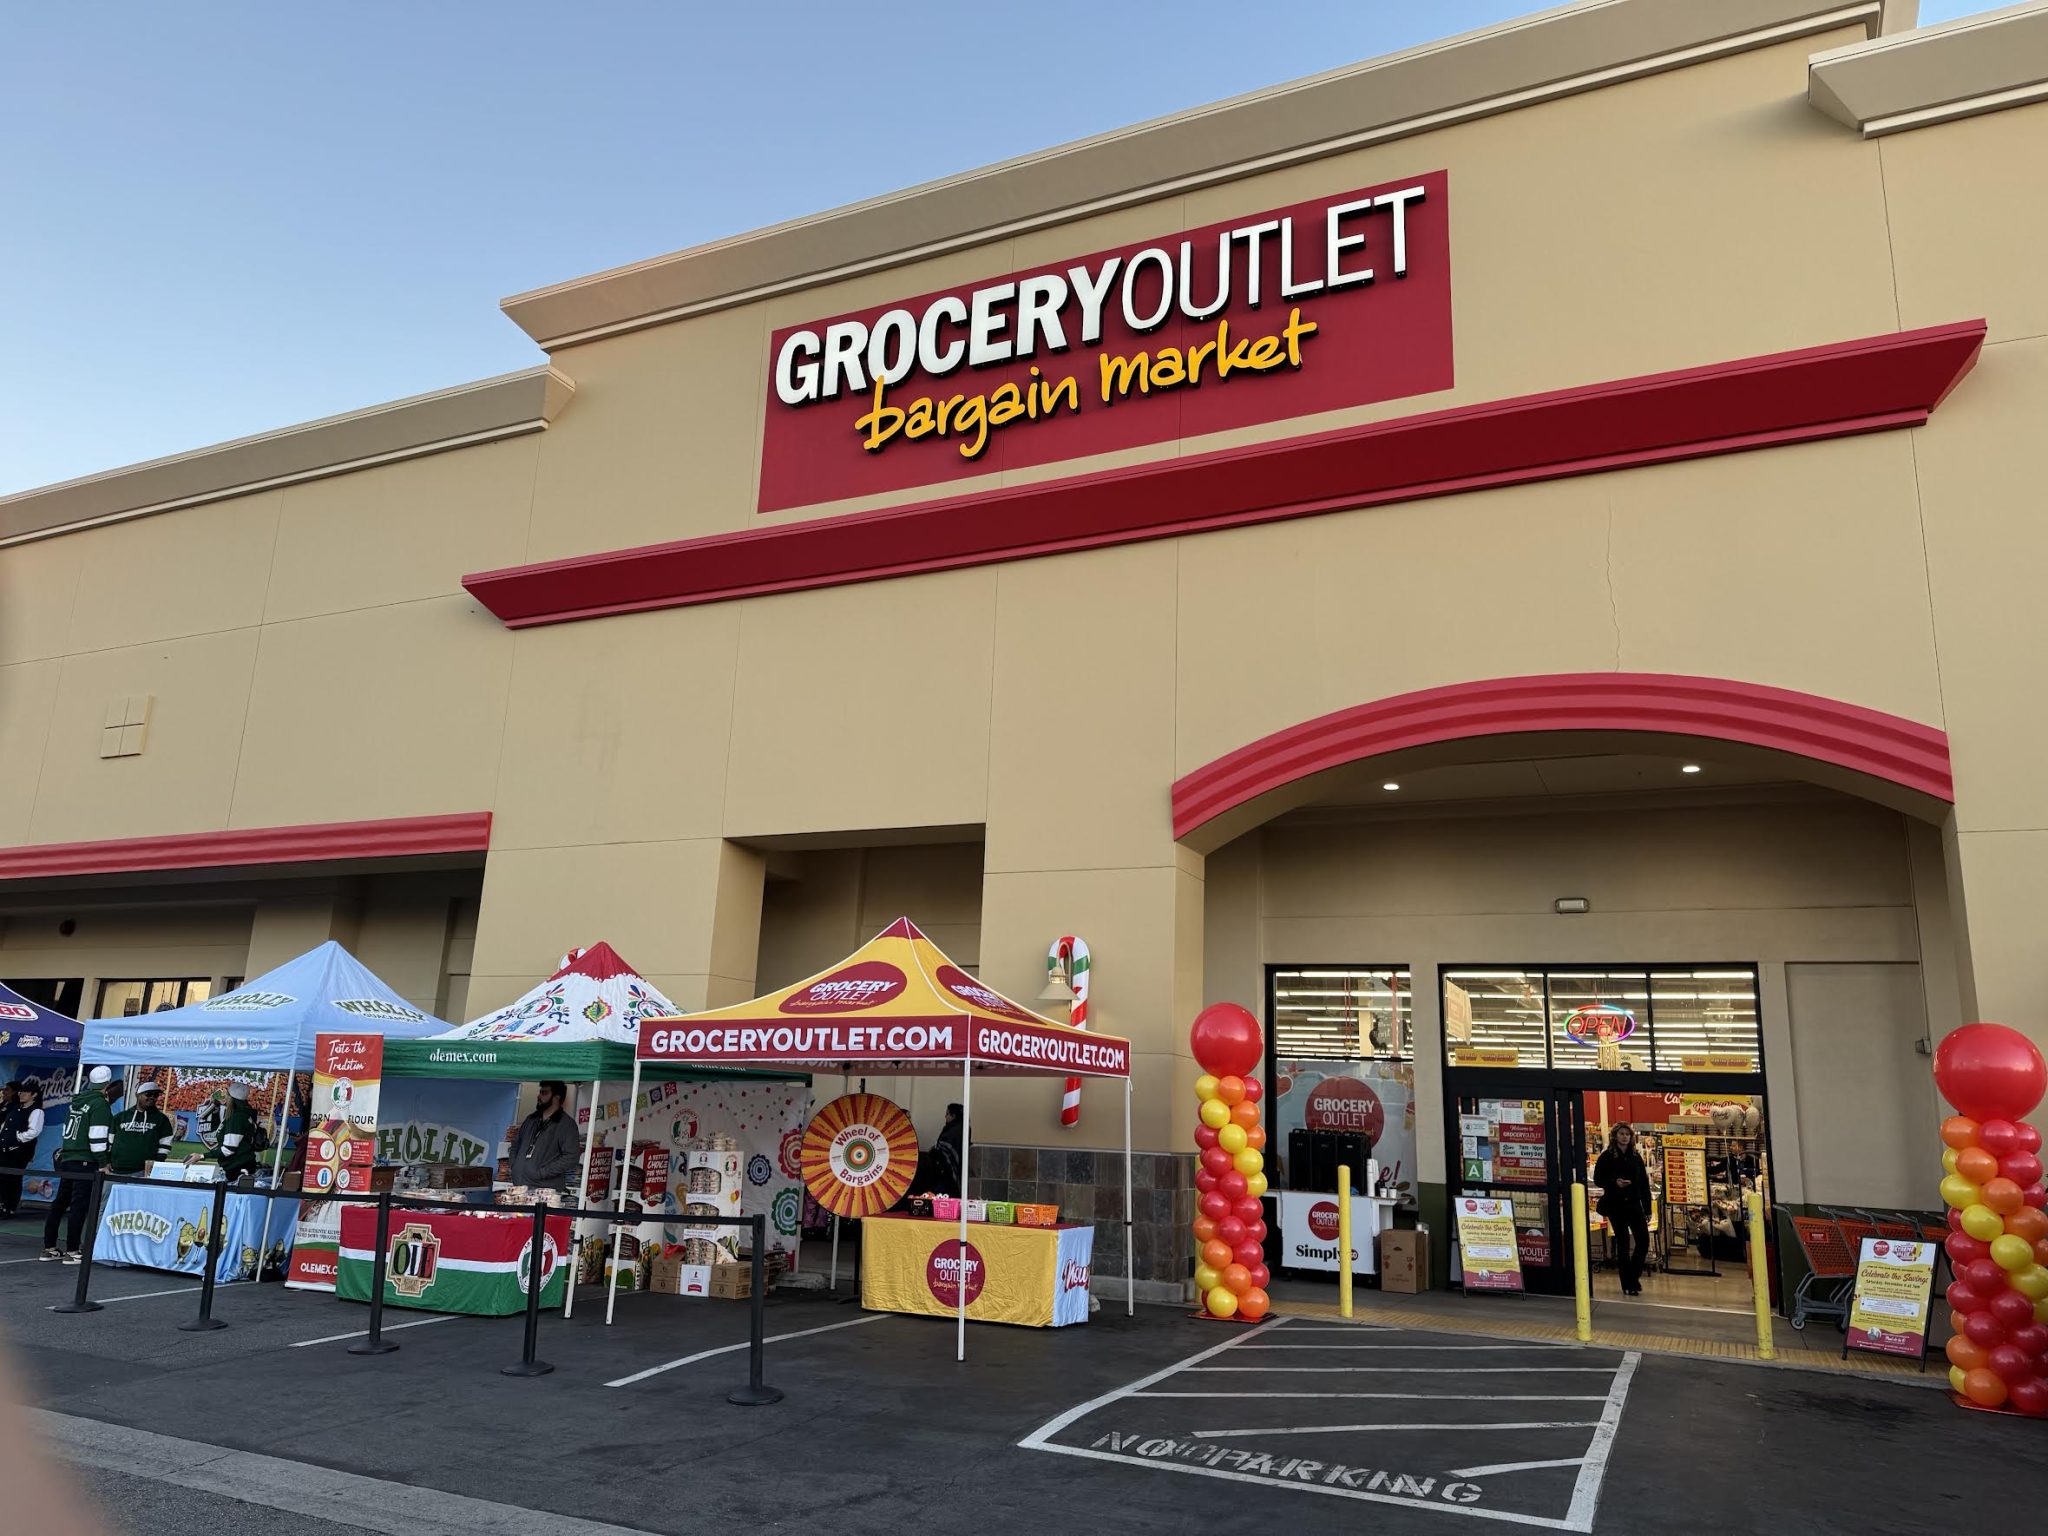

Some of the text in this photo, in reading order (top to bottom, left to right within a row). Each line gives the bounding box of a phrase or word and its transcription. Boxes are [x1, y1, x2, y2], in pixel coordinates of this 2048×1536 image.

[776, 186, 1426, 404] GROCERYOUTLET
[855, 307, 1317, 458] bargain market
[810, 981, 897, 993] GROCERY
[206, 993, 294, 1007] WHOLLY
[810, 991, 875, 1000] OUTLET
[336, 1000, 425, 1021] WHOLLY
[1568, 1016, 1627, 1036] OPEN
[103, 1034, 133, 1047] Follow
[137, 1037, 147, 1047] us
[352, 1040, 367, 1054] the
[651, 1026, 953, 1053] GROCERYOUTLET.COM
[429, 1048, 497, 1063] olemex.com
[978, 1027, 1125, 1070] GROCERYOUTLET.COM
[1313, 1098, 1375, 1113] GROCERY
[348, 1114, 375, 1125] FLOUR
[1322, 1111, 1367, 1127] OUTLET
[377, 1124, 484, 1166] HOLLY
[835, 1127, 881, 1147] Wheel of
[839, 1164, 884, 1186] Bargains
[1468, 1165, 1480, 1177] A
[109, 1211, 170, 1239] WHOLLY
[934, 1257, 979, 1271] GROCRY
[940, 1270, 972, 1282] OUTLT
[1861, 1269, 1929, 1285] Celebrate the Savings
